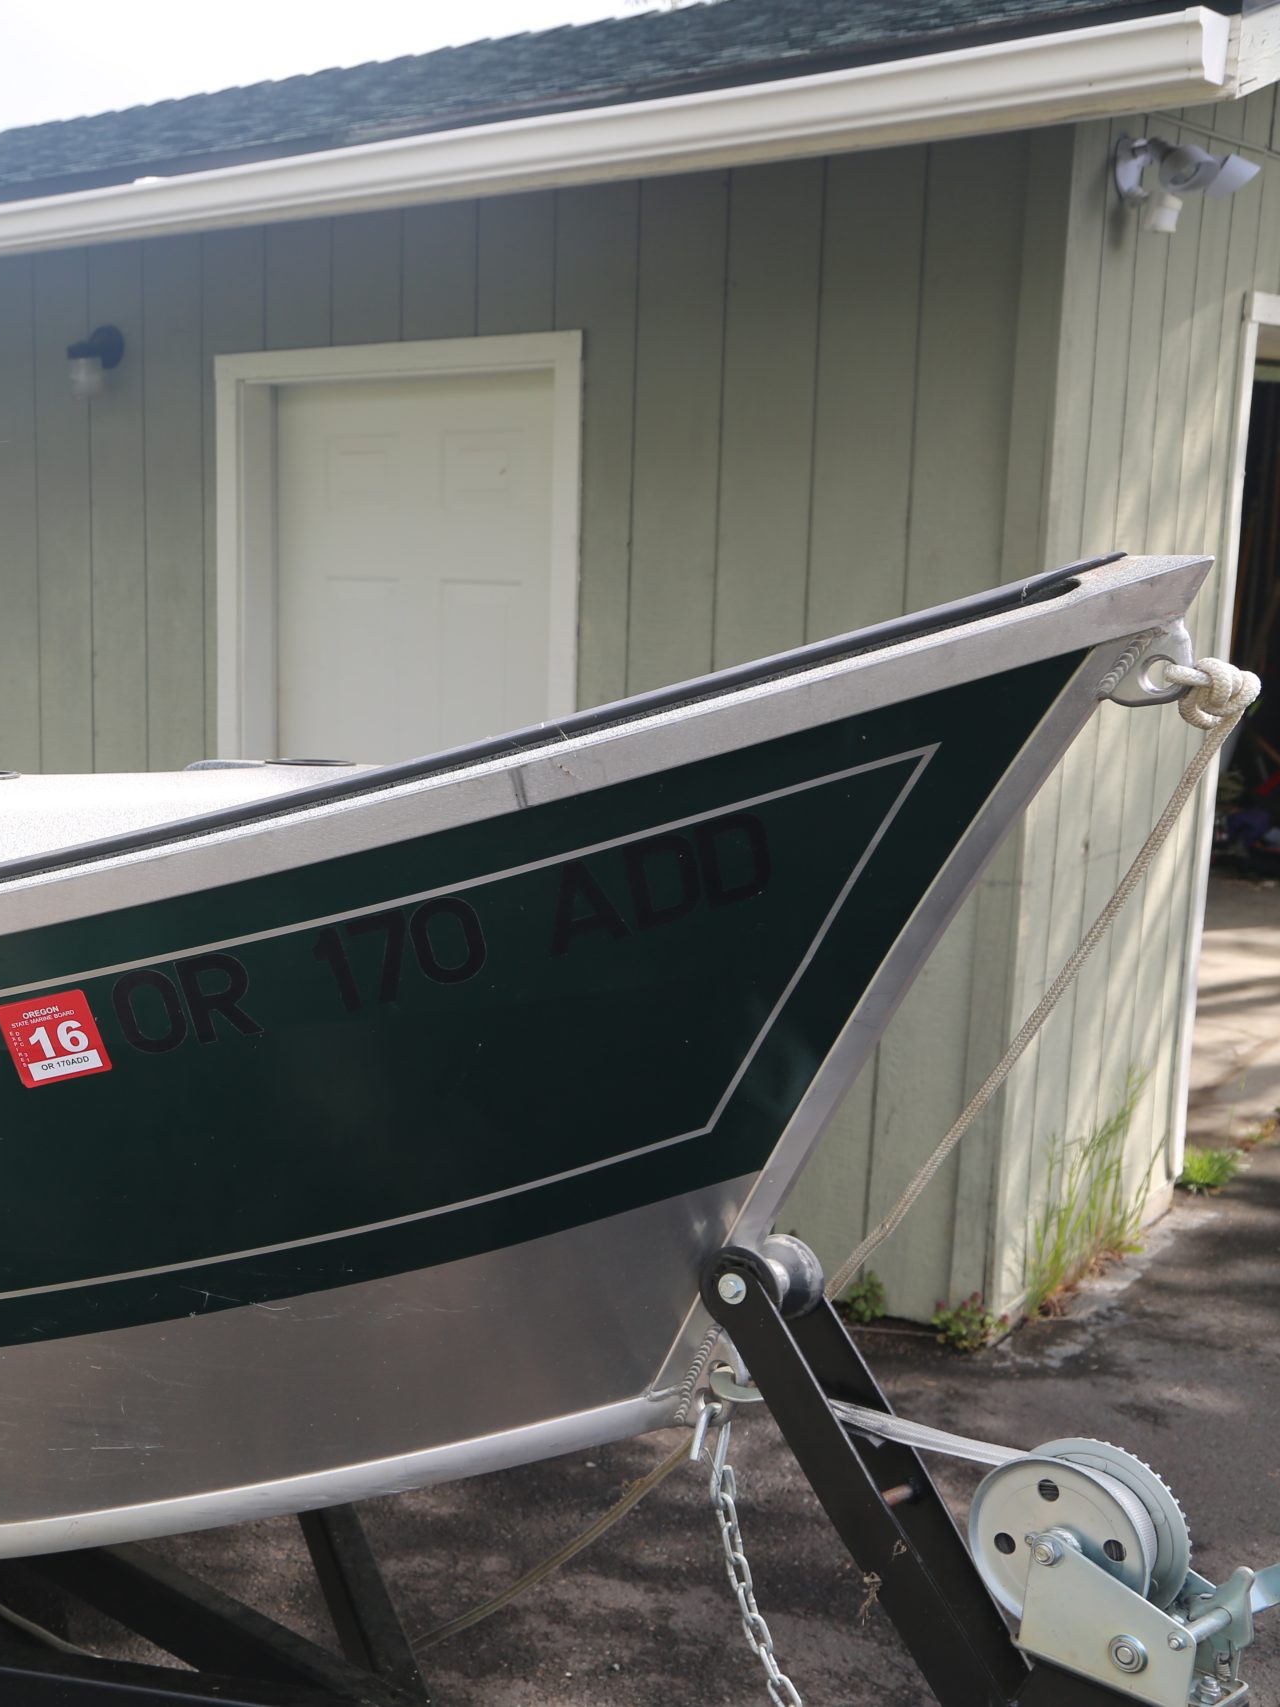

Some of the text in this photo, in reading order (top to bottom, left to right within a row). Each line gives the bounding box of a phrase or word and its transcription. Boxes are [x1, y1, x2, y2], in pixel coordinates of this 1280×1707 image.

[111, 812, 771, 1053] OR 170 ADD
[11, 1009, 75, 1029] STATE MARINE BOARD
[22, 1005, 60, 1020] OREGON
[28, 1020, 89, 1058] 16
[41, 1055, 90, 1071] OR 170ADD
